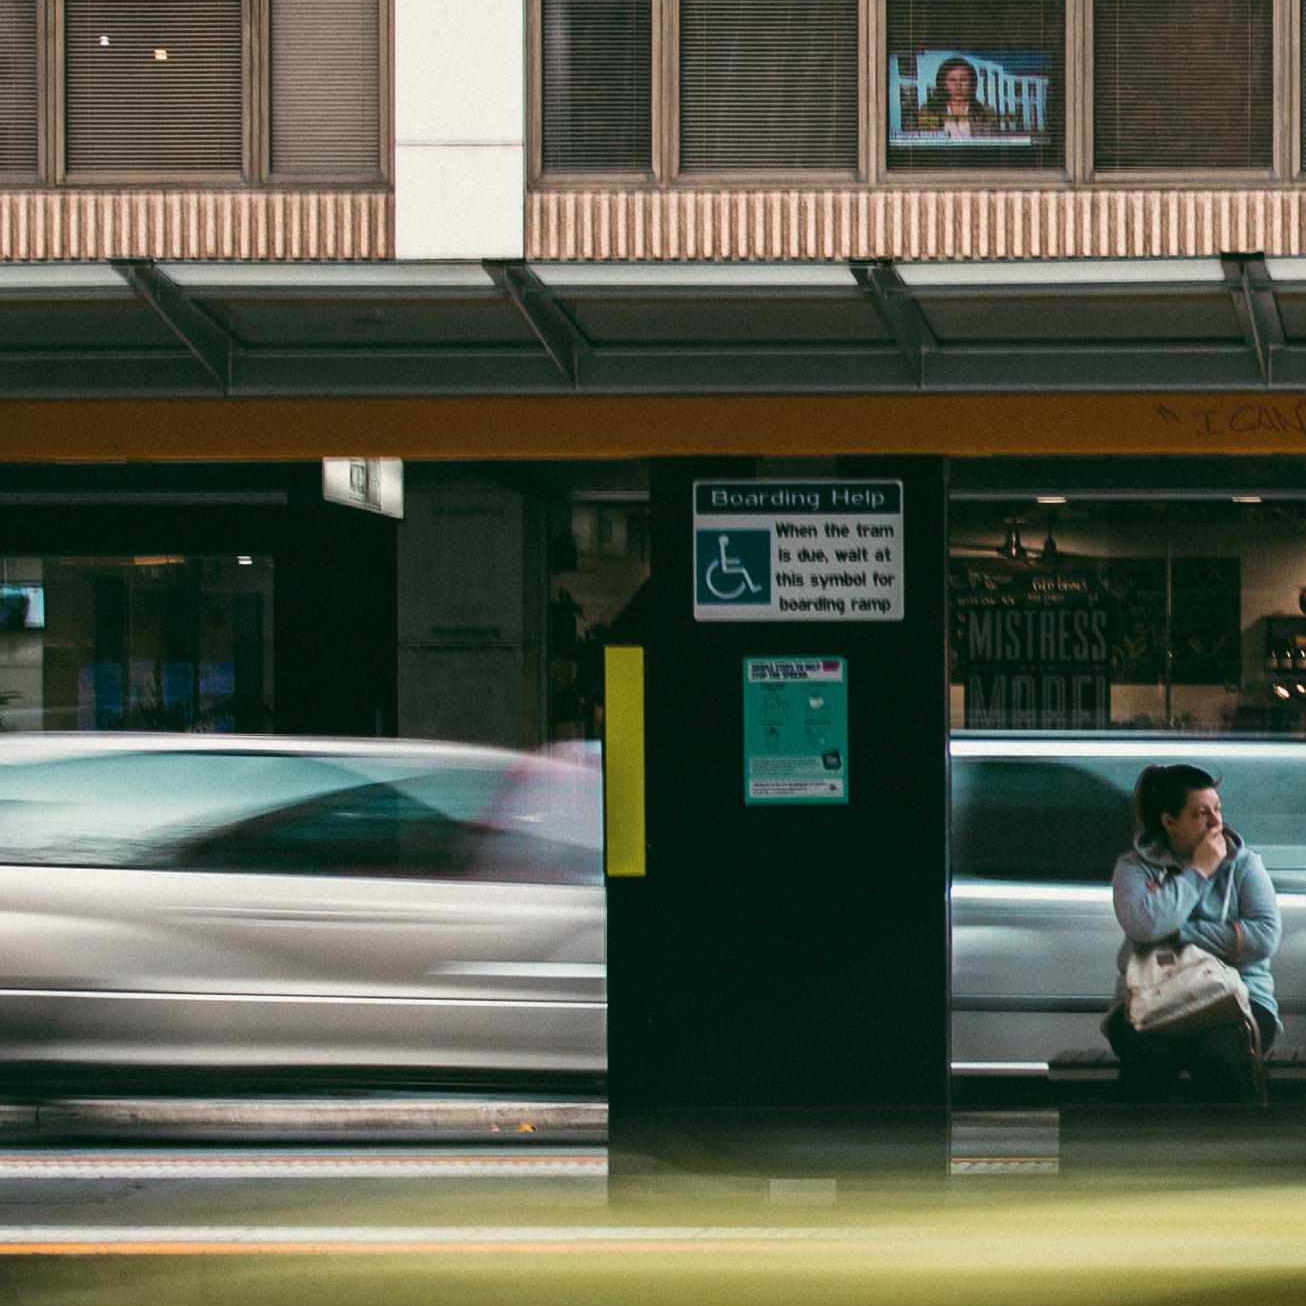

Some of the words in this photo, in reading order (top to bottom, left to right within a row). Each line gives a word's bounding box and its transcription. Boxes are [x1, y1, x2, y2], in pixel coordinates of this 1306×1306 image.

[711, 489, 820, 511] Boarding
[831, 489, 885, 508] Help
[775, 521, 818, 538] When
[824, 521, 849, 538] the
[856, 522, 894, 538] tram
[778, 547, 791, 562] is
[797, 547, 829, 564] due,
[834, 547, 868, 562] wait
[875, 548, 891, 562] at
[775, 572, 804, 587] this
[810, 572, 867, 590] symbol
[873, 572, 895, 587] for
[779, 597, 845, 615] boarding
[851, 599, 891, 614] ramp
[968, 609, 1107, 662] MISTRESS
